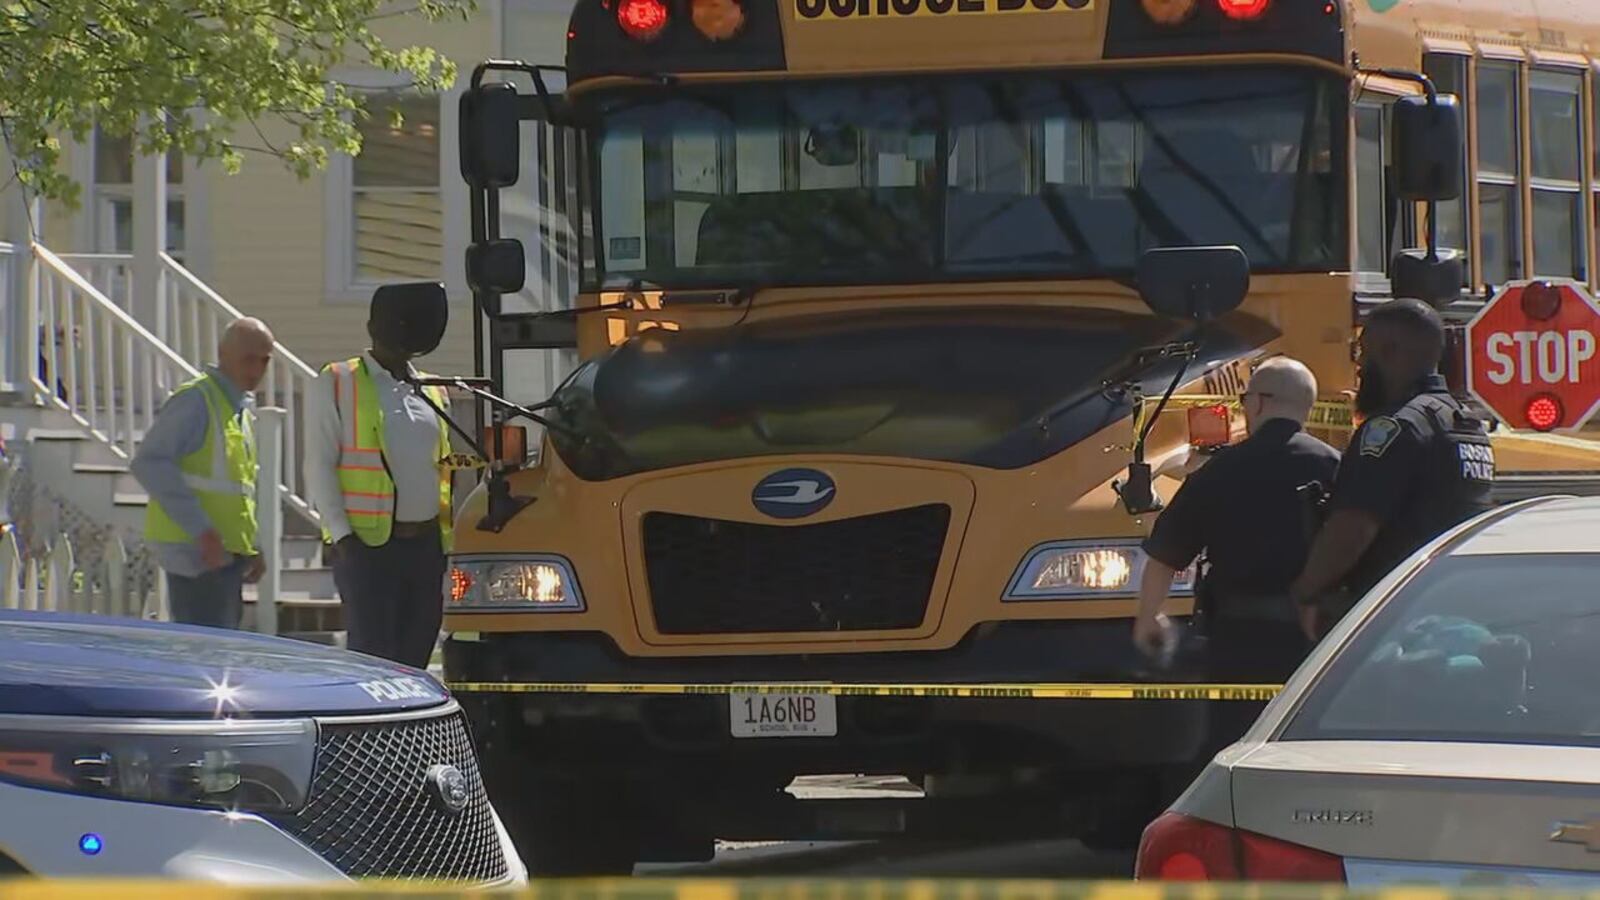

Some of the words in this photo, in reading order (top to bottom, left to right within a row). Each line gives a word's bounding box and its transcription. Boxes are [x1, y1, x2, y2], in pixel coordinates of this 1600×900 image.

[1486, 329, 1596, 385] STOP
[357, 678, 432, 703] POLICE
[744, 696, 816, 723] 1A6NB
